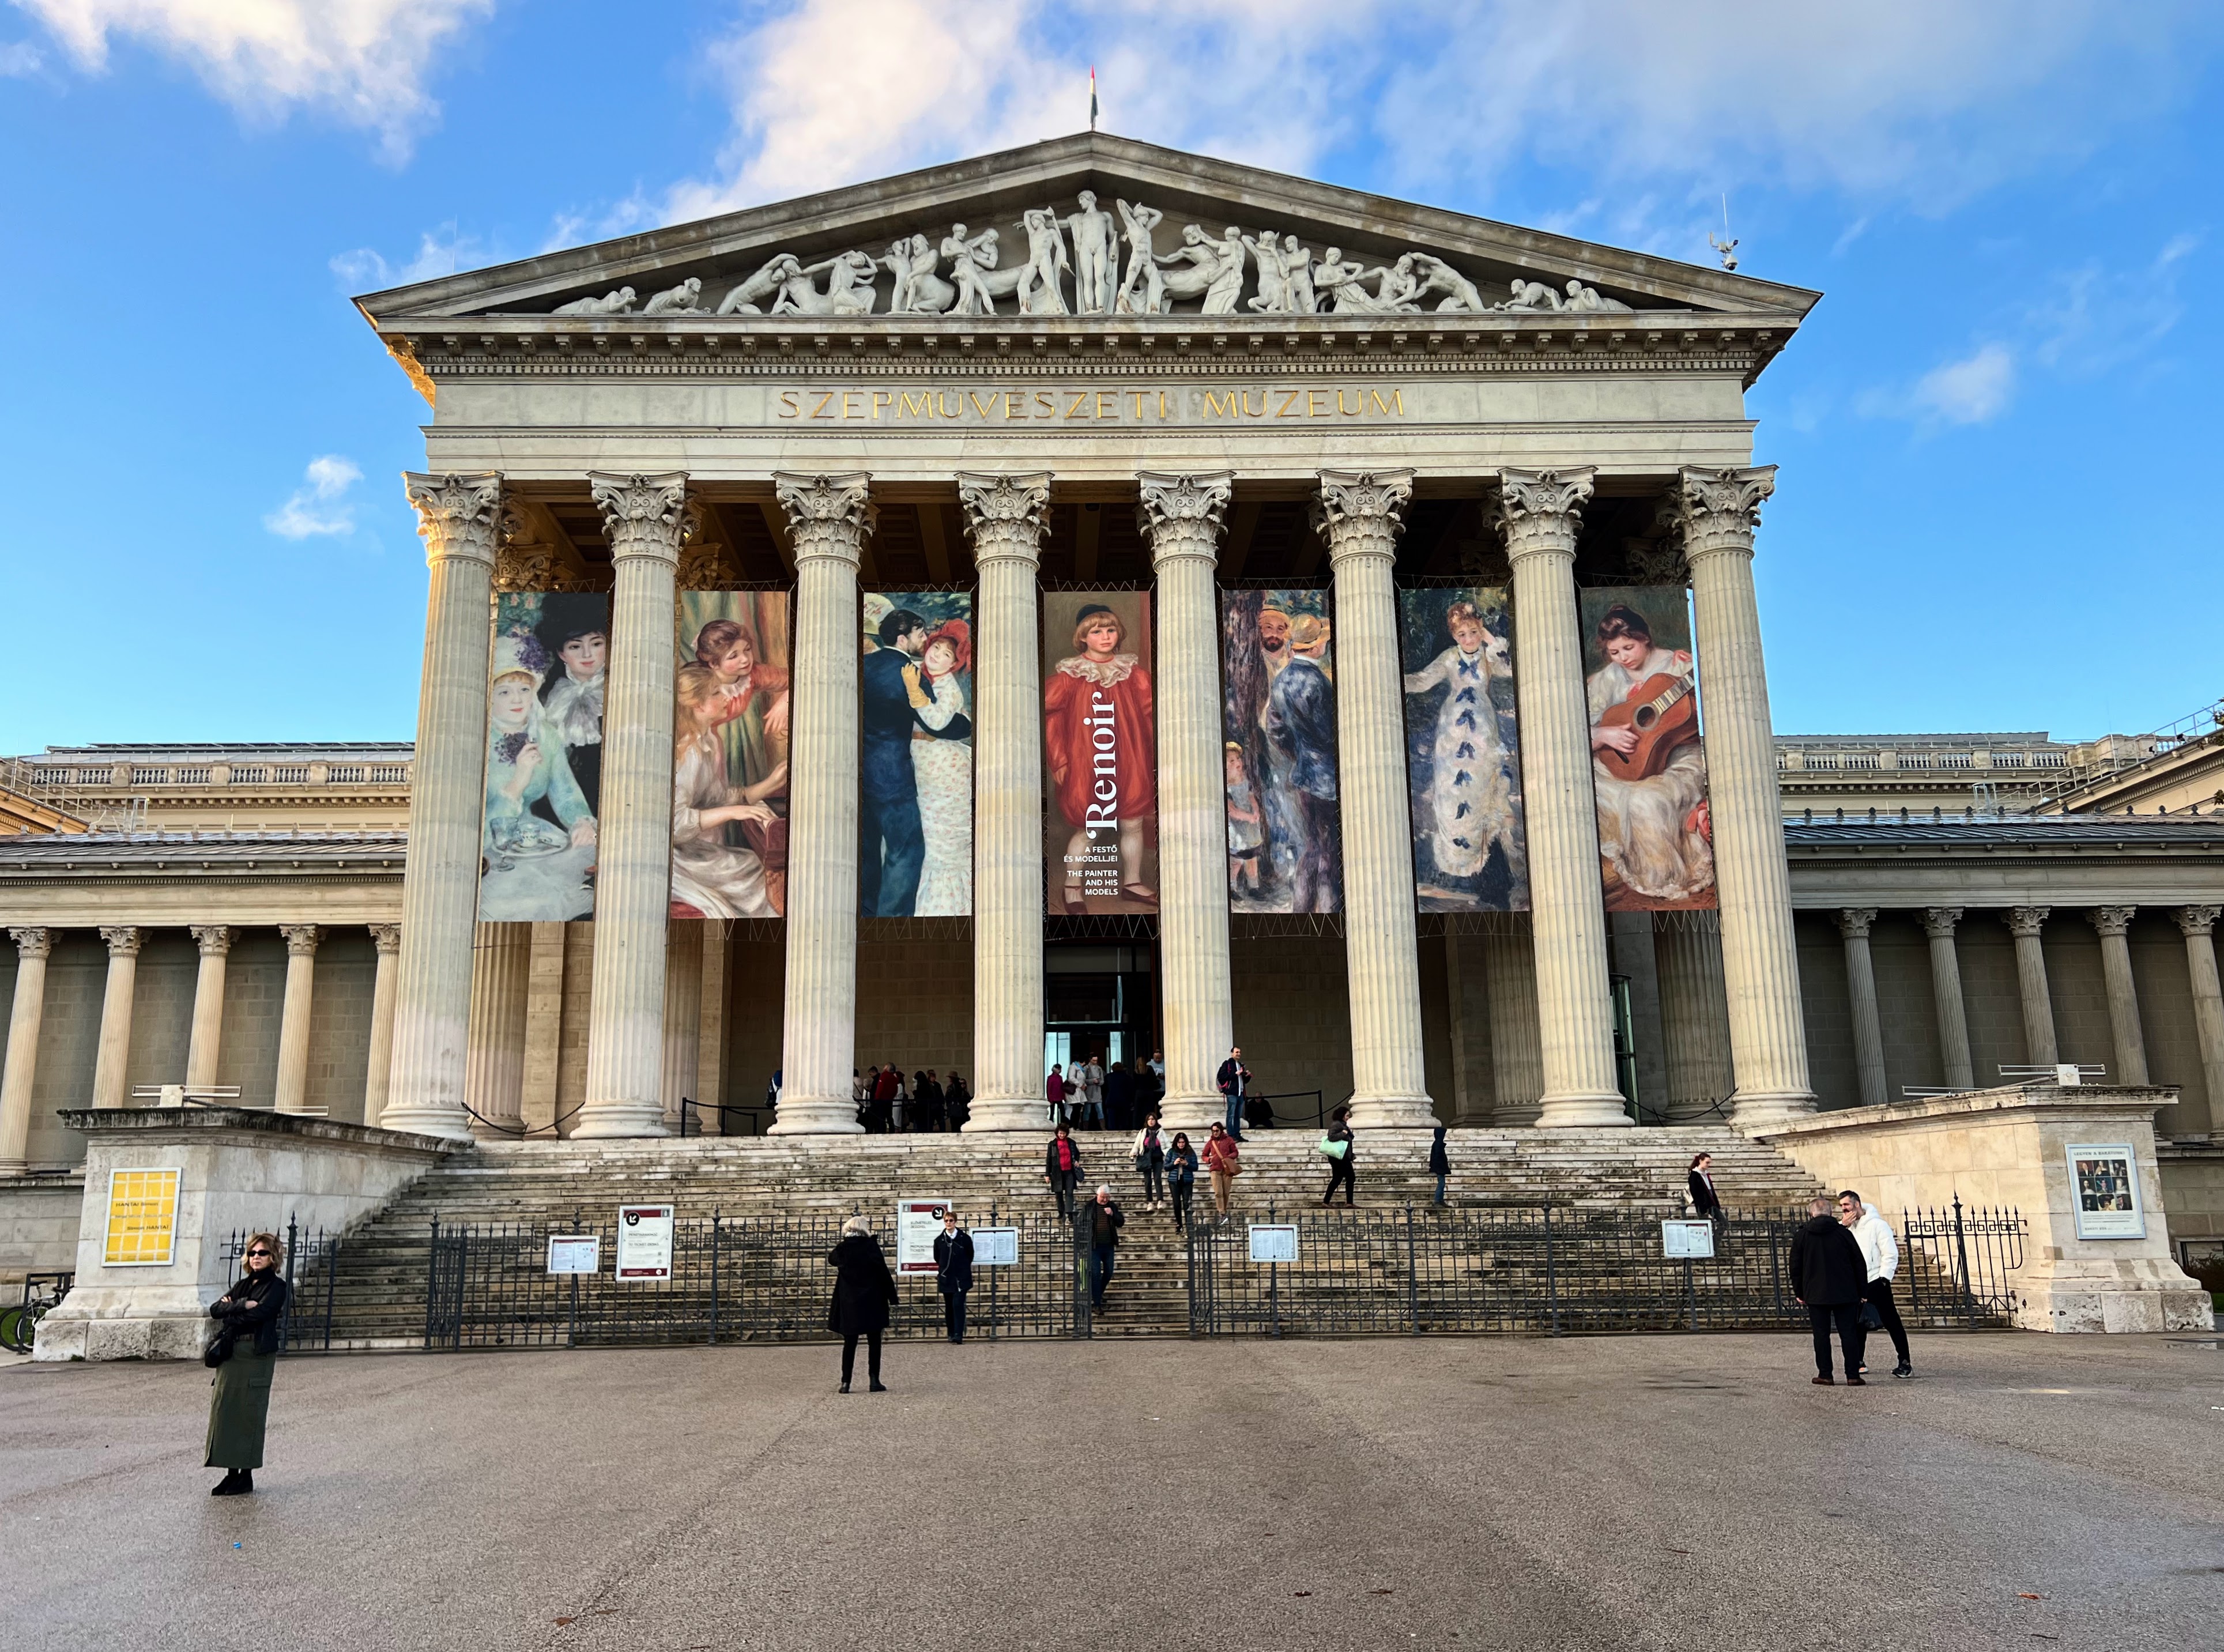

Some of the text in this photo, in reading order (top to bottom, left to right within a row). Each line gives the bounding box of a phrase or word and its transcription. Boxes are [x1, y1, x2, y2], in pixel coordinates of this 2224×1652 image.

[1084, 691, 1117, 839] Renoir
[1092, 844, 1117, 853] FESTŐ
[1064, 854, 1073, 862] ÉS
